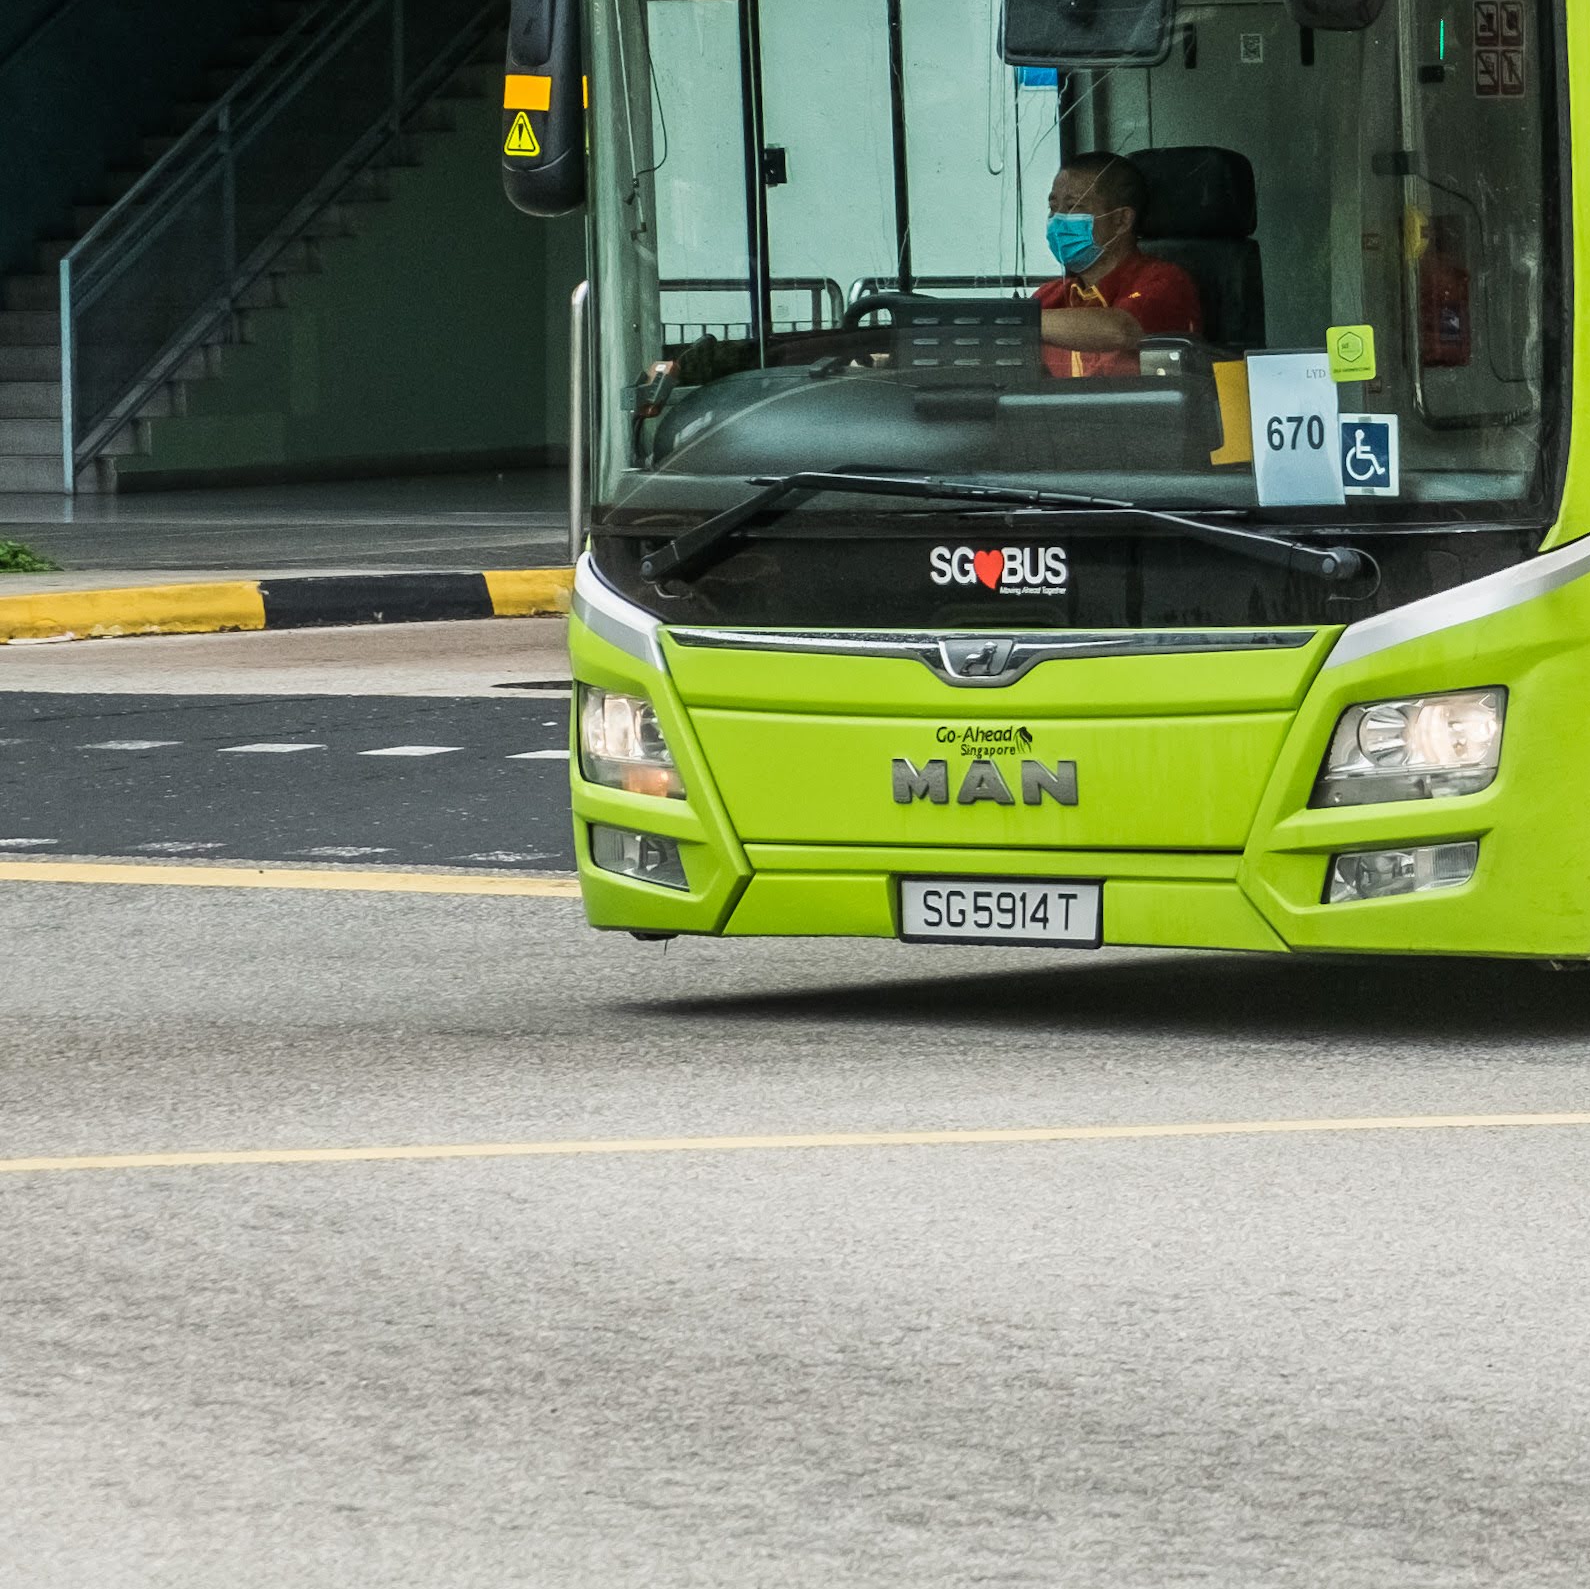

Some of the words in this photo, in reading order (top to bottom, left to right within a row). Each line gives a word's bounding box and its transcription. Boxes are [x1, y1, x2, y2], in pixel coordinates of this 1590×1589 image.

[1267, 414, 1325, 451] 670
[936, 725, 1014, 744] Go-Ahead
[960, 743, 1016, 759] Singapore
[892, 758, 1079, 806] MAN
[923, 890, 1078, 931] SG5914T
